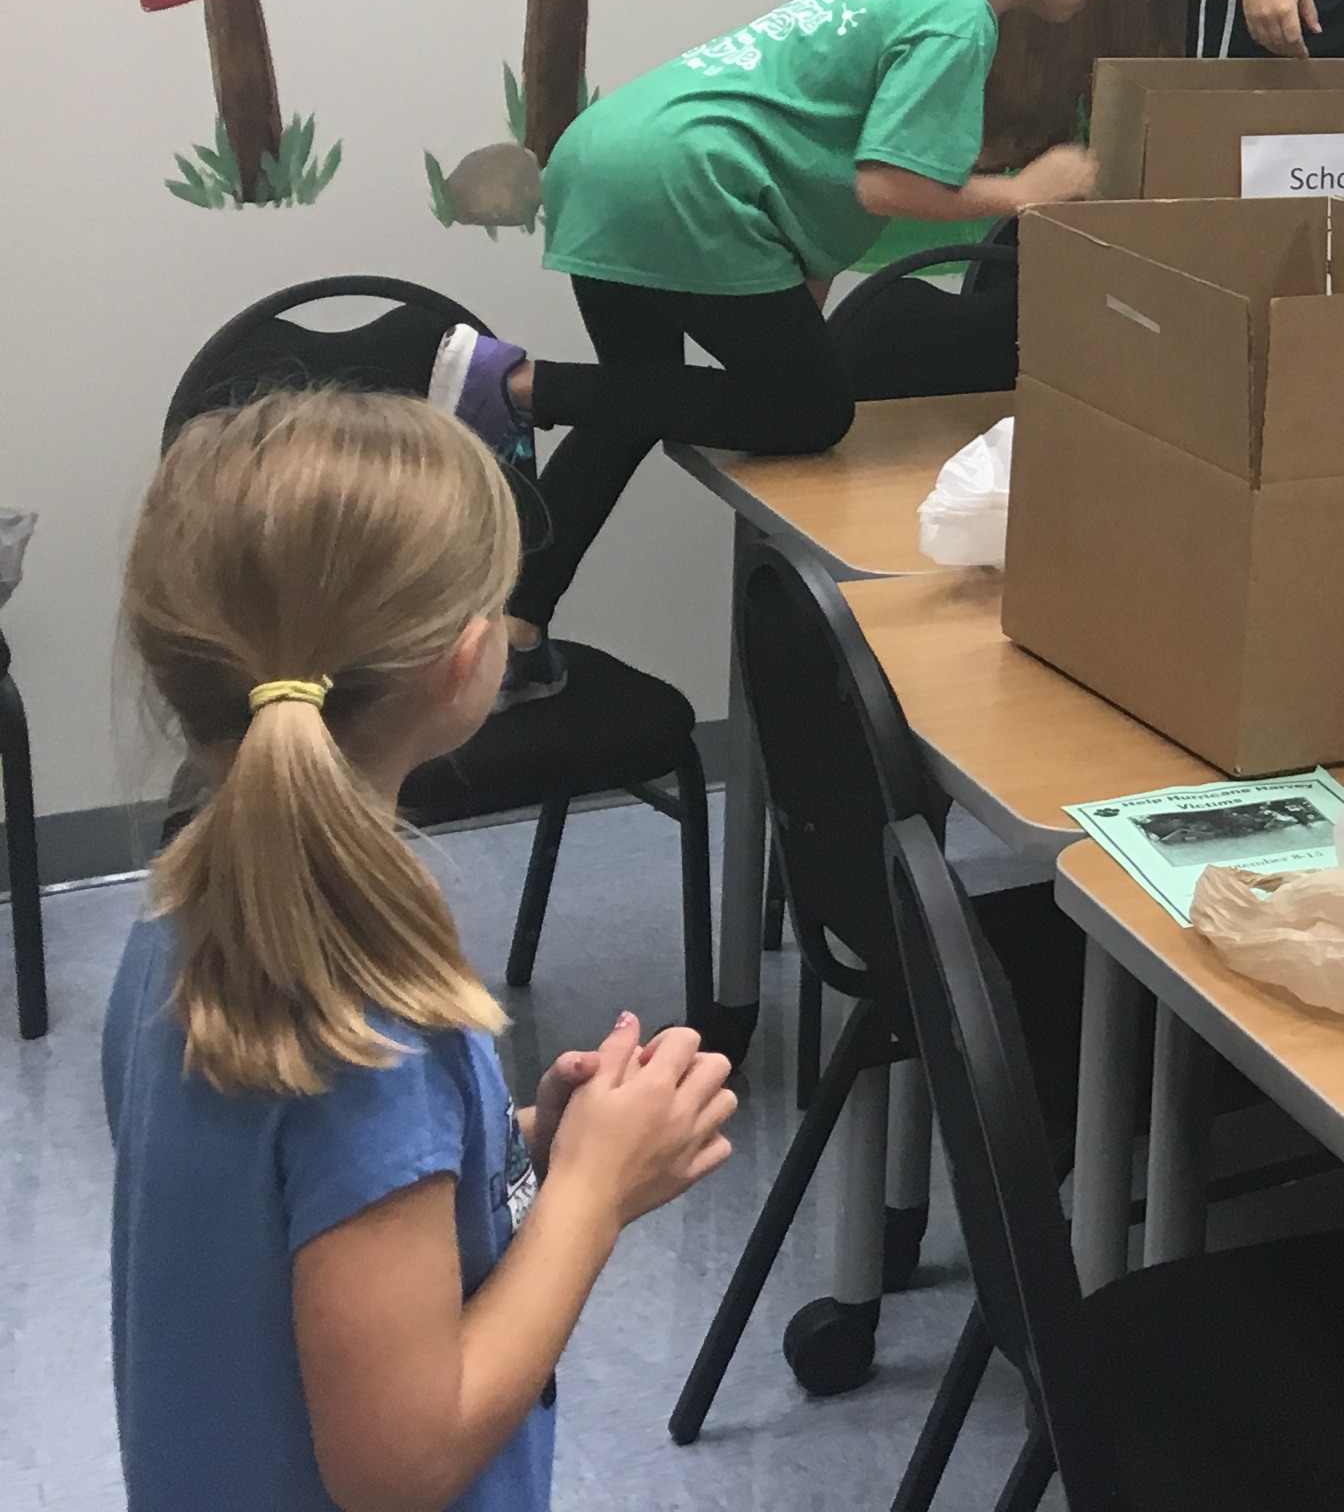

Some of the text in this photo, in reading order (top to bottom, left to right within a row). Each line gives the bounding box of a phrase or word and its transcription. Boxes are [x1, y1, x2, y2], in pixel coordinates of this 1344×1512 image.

[1120, 780, 1316, 809] Help Hurricane Harvey
[1176, 797, 1244, 811] Victims
